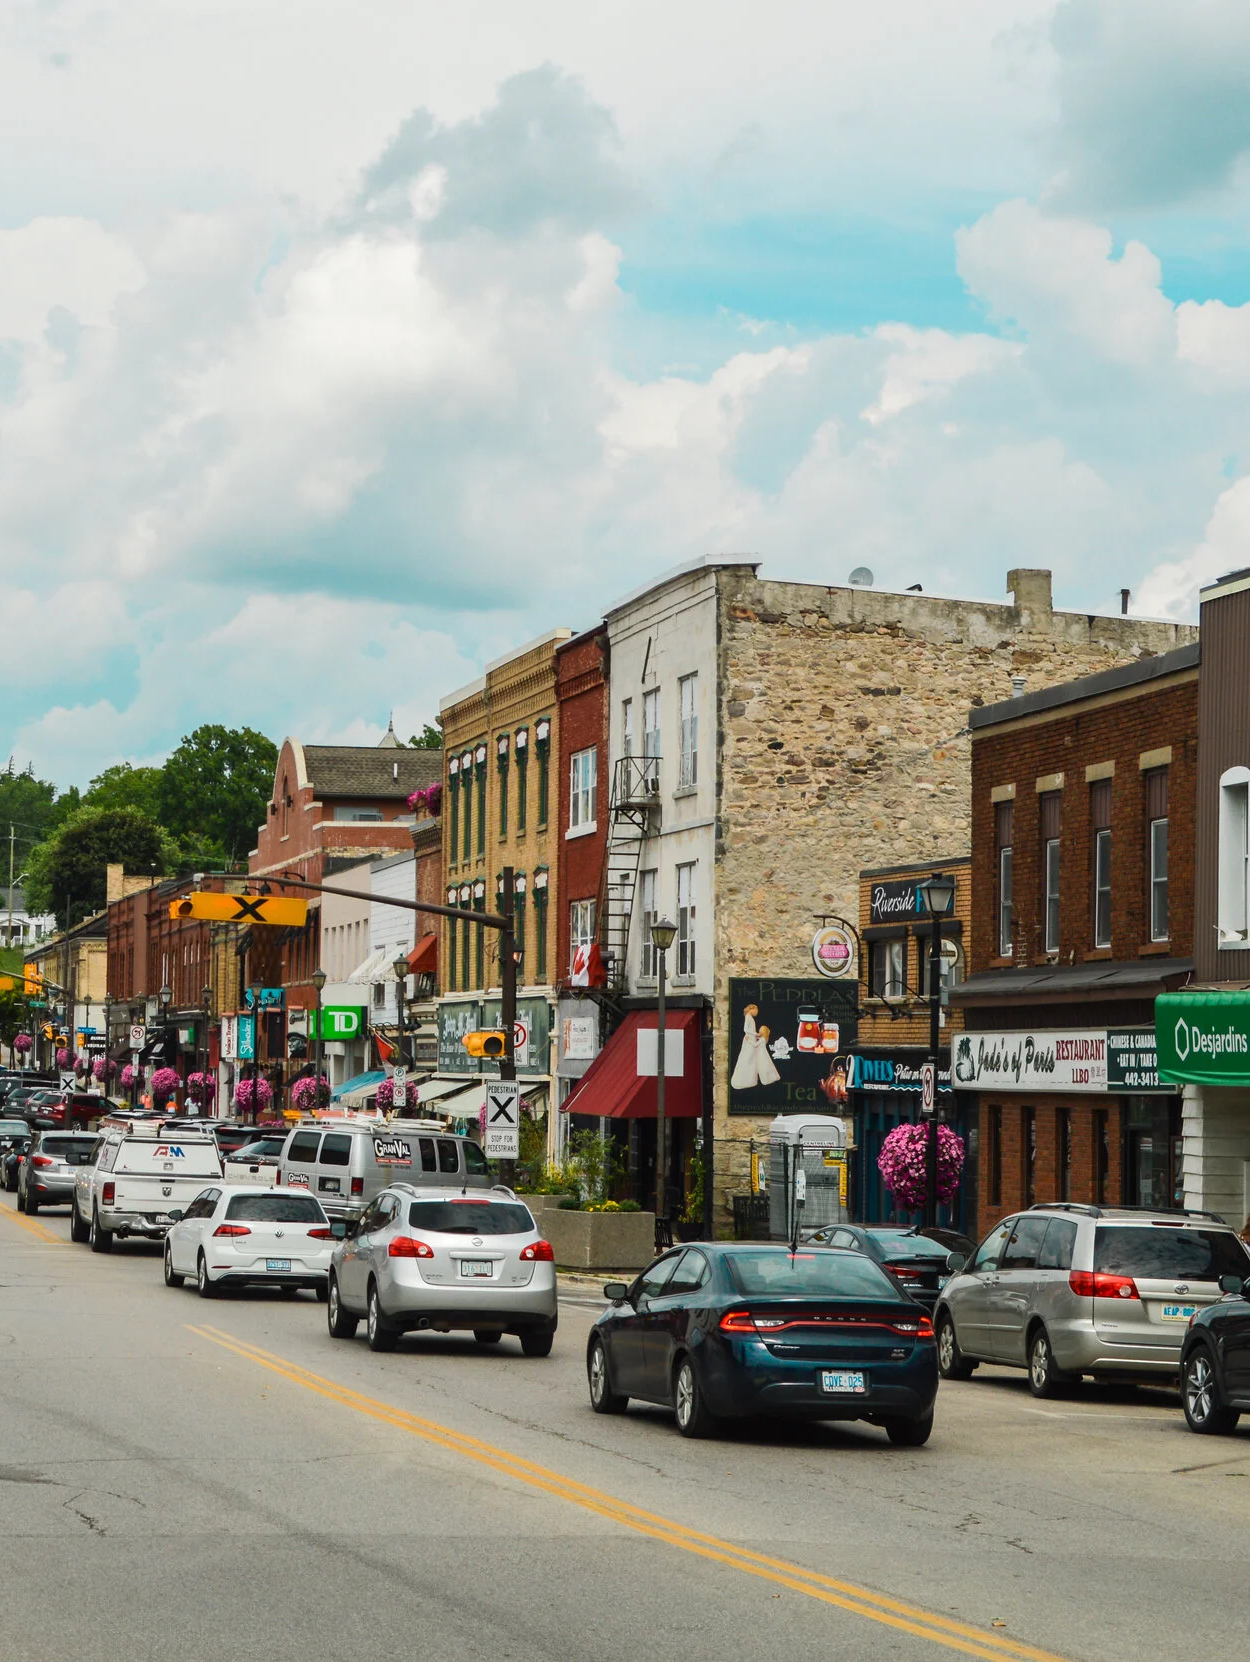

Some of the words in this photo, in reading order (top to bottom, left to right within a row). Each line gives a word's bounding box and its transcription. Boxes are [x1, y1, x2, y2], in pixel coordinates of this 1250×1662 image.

[871, 886, 915, 920] Riverside
[736, 985, 756, 997] The
[758, 981, 855, 1001] PEDDLAR
[328, 1011, 359, 1033] TD
[1135, 1034, 1157, 1048] CANADIA
[1191, 1026, 1248, 1060] Desjardins
[977, 1036, 1009, 1082] Jade's
[1011, 1040, 1023, 1083] of
[1024, 1036, 1056, 1074] Paris
[1055, 1039, 1106, 1062] RESTAURANT
[1120, 1053, 1130, 1067] EAT
[1140, 1053, 1153, 1067] TAKE
[893, 1063, 913, 1084] Patio
[1071, 1067, 1090, 1084] LLBO
[1124, 1071, 1159, 1086] 442-3413
[488, 1085, 517, 1094] PEDESTRIAN
[783, 1081, 817, 1101] Tea
[491, 1134, 503, 1142] STOP
[503, 1134, 513, 1142] FOR
[487, 1144, 517, 1152] PEDESTRIANS
